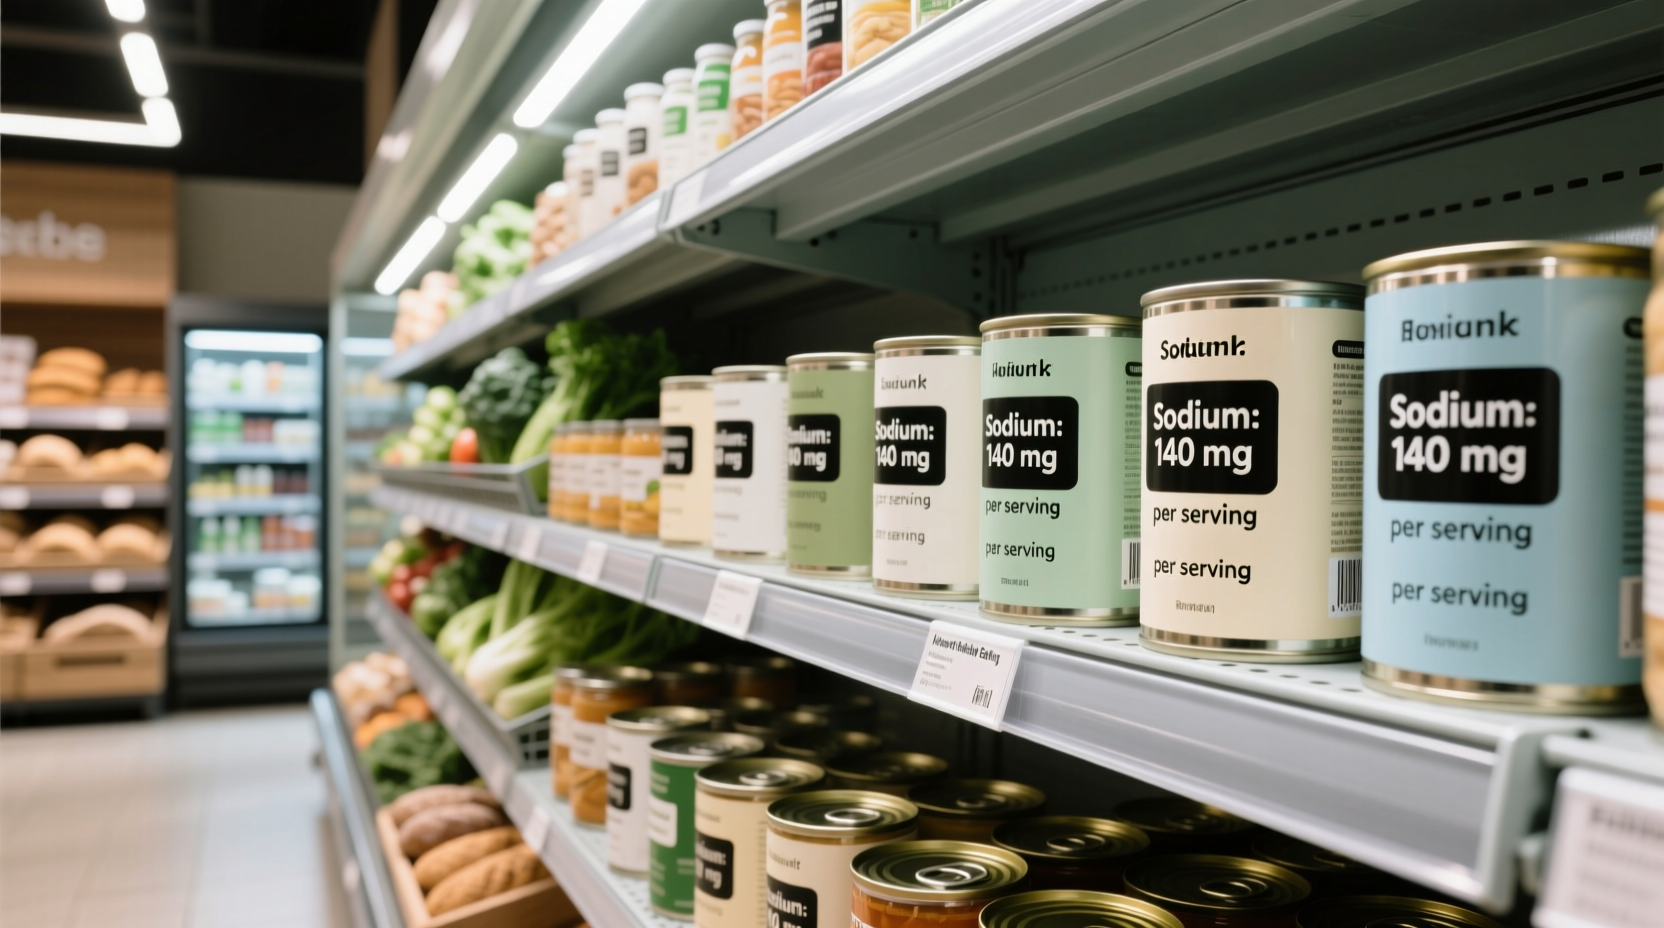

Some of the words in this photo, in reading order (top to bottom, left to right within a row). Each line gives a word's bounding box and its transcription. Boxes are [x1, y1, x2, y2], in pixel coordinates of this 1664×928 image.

[985, 411, 1063, 437] Sodium:
[1153, 399, 1260, 431] Sodium:
[1390, 390, 1537, 429] Sodium:
[875, 418, 935, 441] Sodium:
[803, 451, 828, 472] mg
[875, 444, 898, 467] 140
[901, 450, 930, 473] mg
[986, 442, 1015, 468] 140
[1020, 449, 1058, 475] mg
[1154, 436, 1195, 467] 140
[1203, 445, 1253, 476] mg
[1391, 435, 1451, 473] 140
[1461, 445, 1527, 484] mg
[986, 499, 1002, 516] per
[1004, 496, 1061, 520] serving
[1153, 507, 1177, 527] per
[1181, 503, 1257, 531] serving
[1391, 519, 1424, 543] per
[1431, 516, 1533, 550] serving
[1003, 541, 1056, 562] serving
[1154, 559, 1176, 578] per
[1180, 559, 1251, 585] serving
[1392, 582, 1425, 605] per
[1431, 583, 1529, 616] serving
